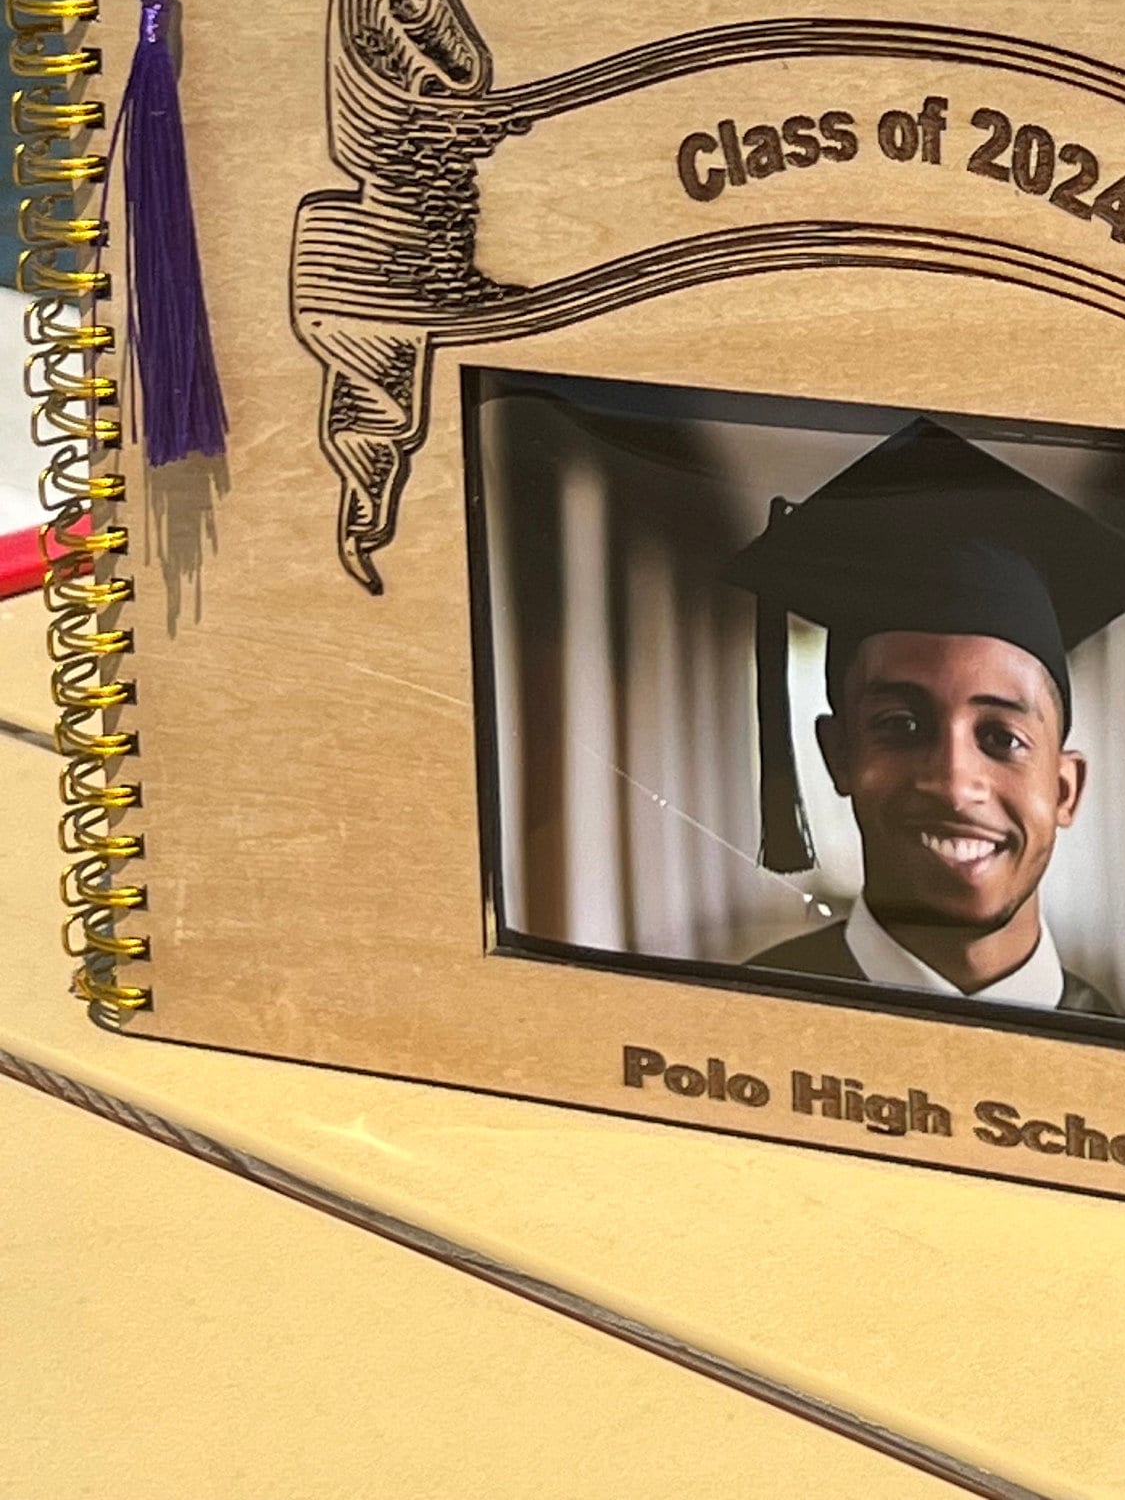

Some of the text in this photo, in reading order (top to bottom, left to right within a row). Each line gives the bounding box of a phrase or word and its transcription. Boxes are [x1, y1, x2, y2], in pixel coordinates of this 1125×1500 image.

[676, 109, 858, 202] Class
[878, 96, 949, 166] of
[622, 1045, 770, 1107] Polo
[791, 1070, 952, 1137] High
